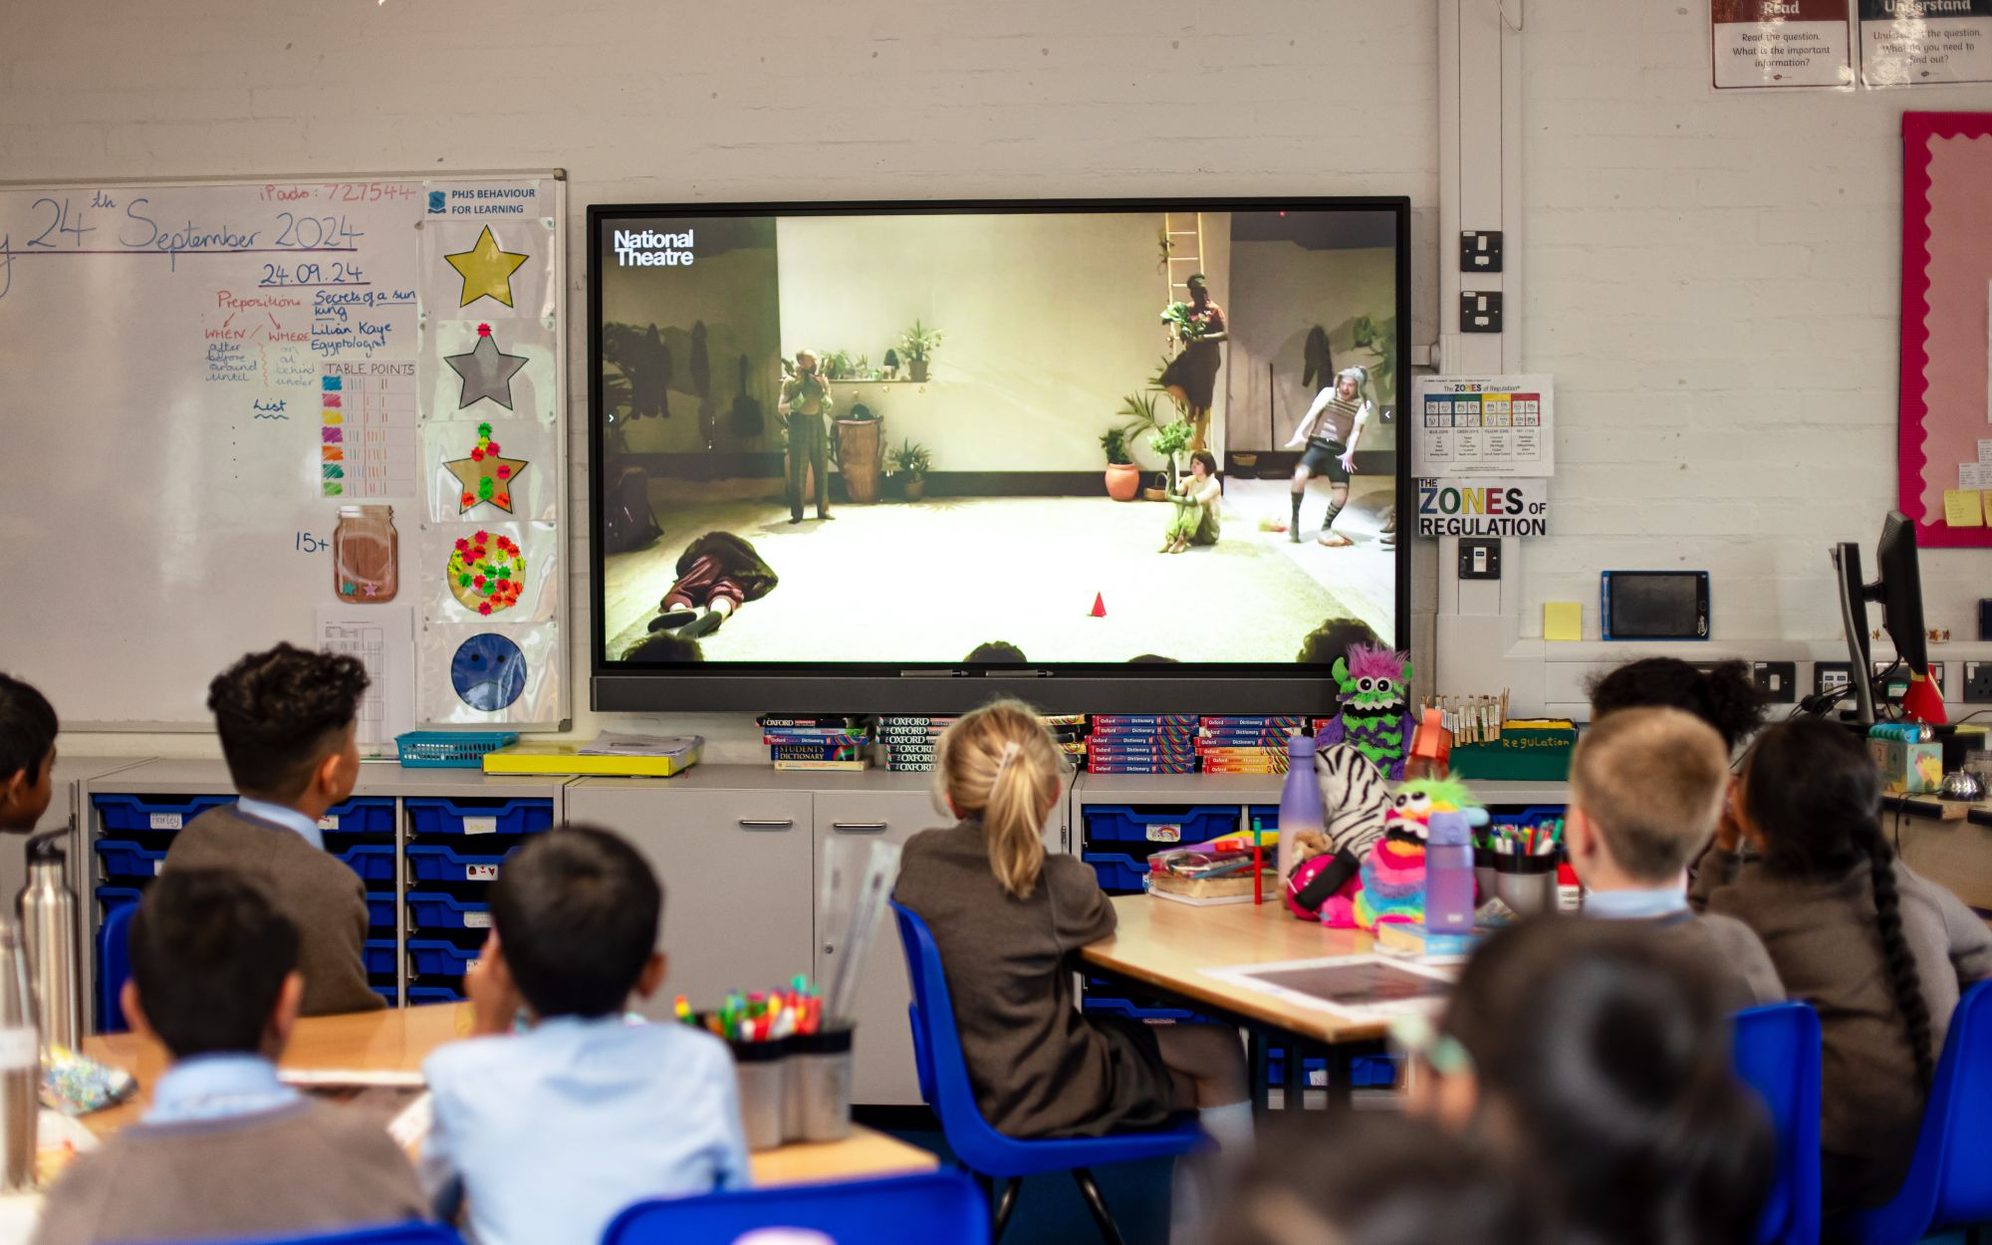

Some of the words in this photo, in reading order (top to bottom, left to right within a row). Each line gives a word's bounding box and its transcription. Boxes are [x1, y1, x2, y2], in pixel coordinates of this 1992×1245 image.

[1763, 1, 1800, 14] Read
[1884, 0, 1971, 12] Unerstand
[1742, 33, 1763, 41] Read
[1927, 30, 1941, 38] the
[1733, 47, 1757, 55] What
[1770, 46, 1785, 54] the
[1787, 46, 1830, 56] important
[1923, 44, 1939, 54] you
[1943, 43, 1963, 51] need
[1966, 42, 1974, 51] to
[1929, 55, 1949, 64] out?
[323, 182, 417, 202] 727544
[452, 190, 475, 199] PHJS
[477, 188, 535, 199] BEHAVIOUR
[452, 205, 471, 215] FOR
[474, 204, 524, 214] LEARNING
[119, 198, 262, 273] September
[275, 212, 364, 249] 2024
[613, 229, 694, 249] National
[614, 248, 694, 266] Theatre
[260, 262, 364, 286] 24.09.24
[313, 290, 361, 305] Secrets
[362, 291, 374, 307] of
[377, 291, 387, 300] a
[392, 290, 416, 300] sun
[315, 305, 348, 322] king
[205, 328, 246, 340] WHEN
[268, 331, 310, 342] WHERE
[359, 321, 392, 338] Kaye
[325, 363, 367, 375] TABLE
[371, 363, 416, 375] POINTS
[253, 399, 287, 411] List
[1420, 479, 1437, 487] THE
[1419, 487, 1523, 515] ZONES
[1528, 503, 1546, 514] OF
[1420, 518, 1546, 536] REGULATION
[295, 532, 330, 553] 15+
[892, 717, 930, 726] OXFORD
[889, 726, 927, 735] OXFORD
[888, 735, 926, 744] OXFORD
[901, 753, 938, 762] OXFORD
